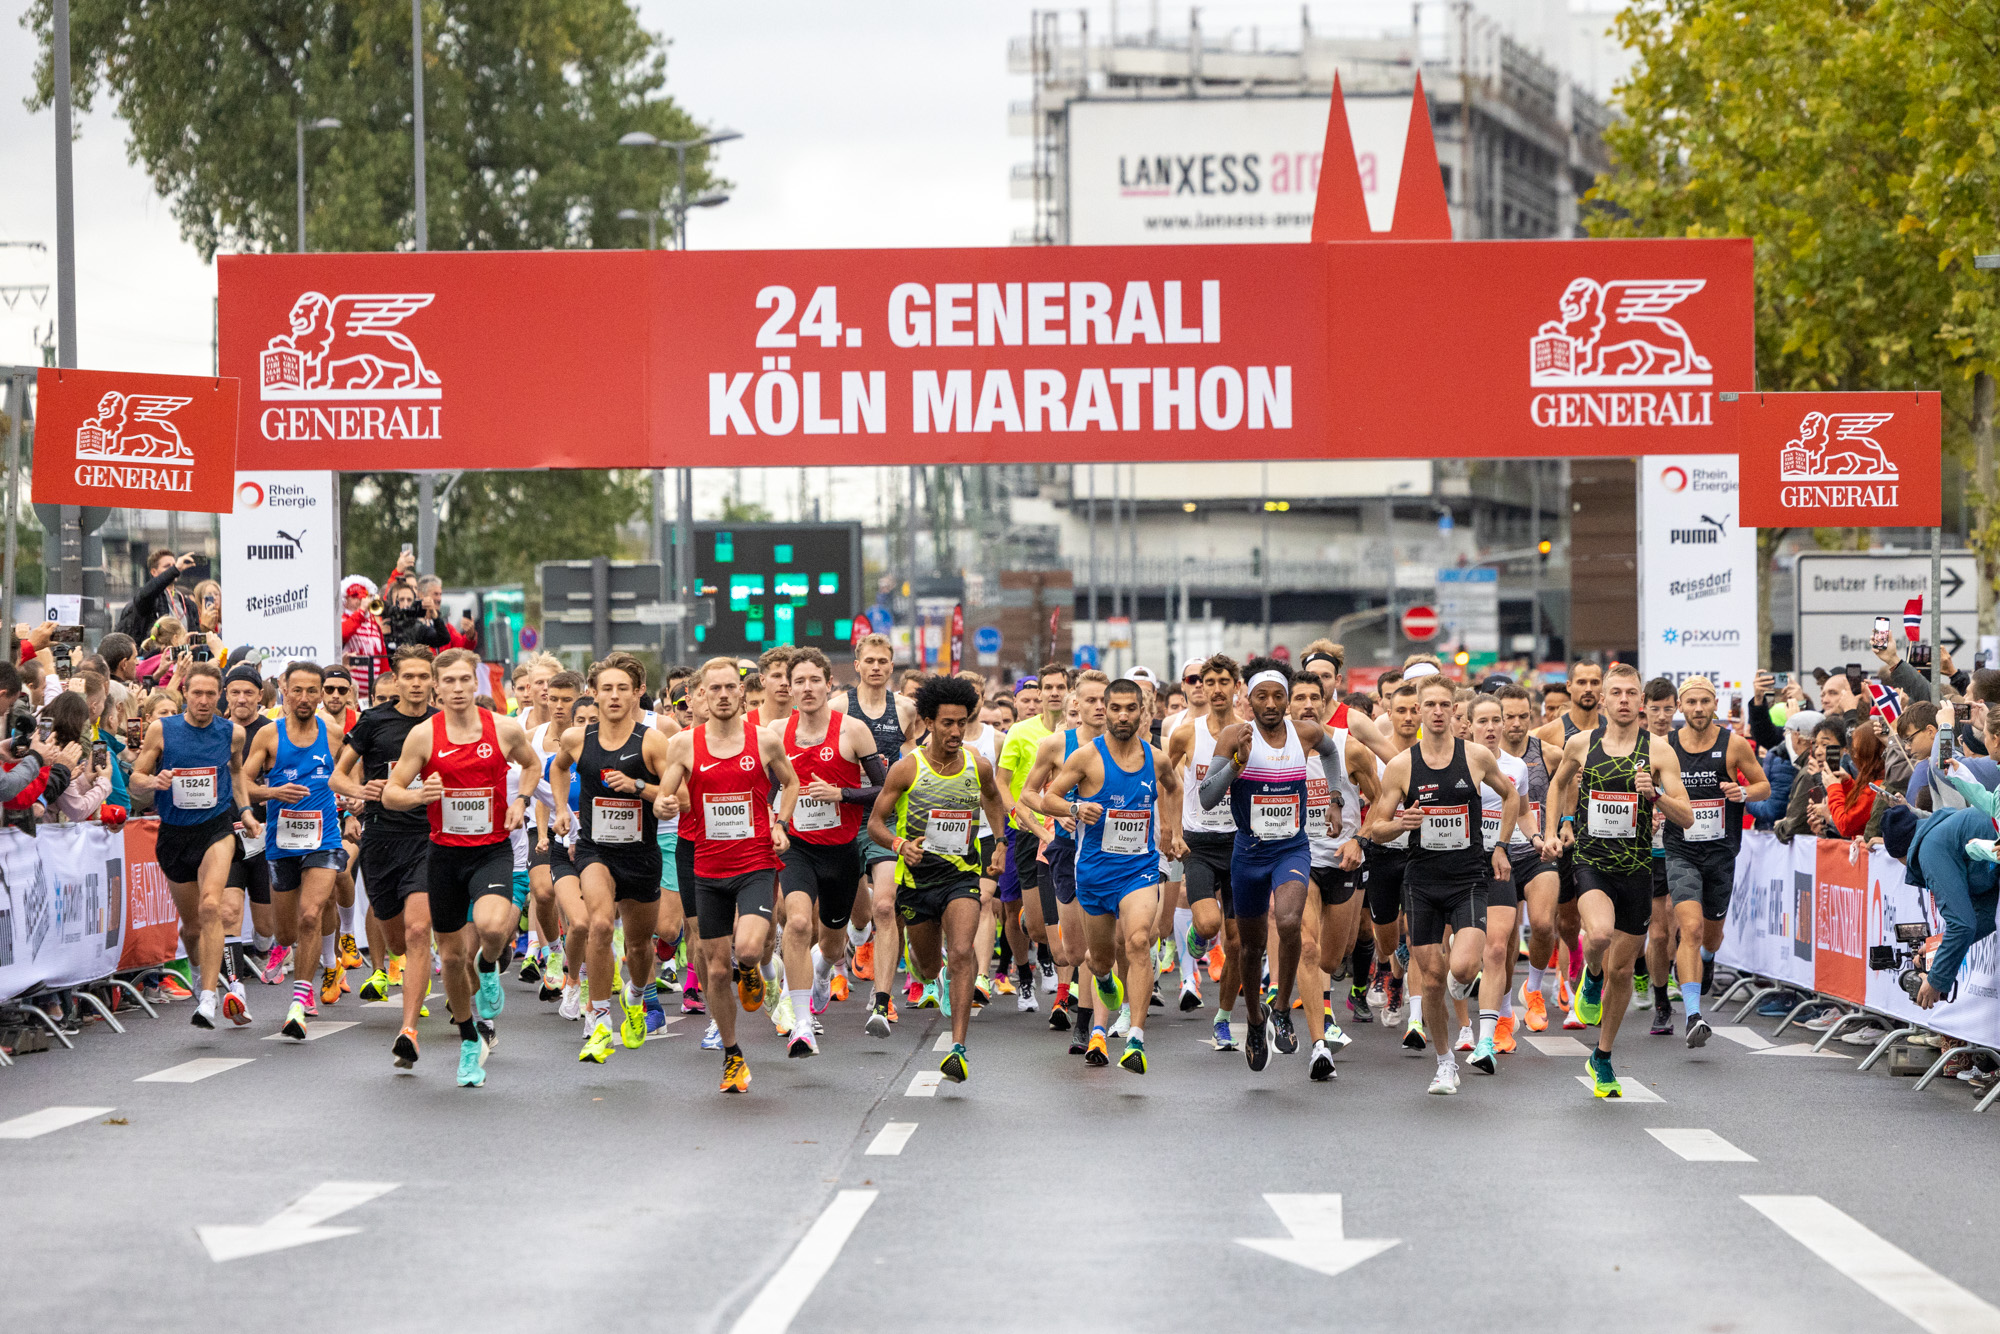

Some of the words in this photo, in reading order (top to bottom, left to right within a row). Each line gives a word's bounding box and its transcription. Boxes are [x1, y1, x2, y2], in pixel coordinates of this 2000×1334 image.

[1119, 153, 1261, 197] LANXESS
[1271, 152, 1377, 194] area
[755, 285, 862, 348] 24.
[887, 279, 1221, 348] GENERALI
[708, 355, 887, 436] KÖLN
[912, 365, 1293, 433] MARATHON
[1530, 391, 1713, 428] GENERALI
[260, 405, 442, 441] GENERALI
[74, 464, 194, 492] GENERALI
[1692, 469, 1728, 480] Rhein
[269, 484, 304, 495] Rhein
[269, 496, 316, 509] Energie
[1780, 485, 1899, 508] GENERALI
[1671, 529, 1718, 544] PUMA
[247, 544, 297, 560] PUMA
[1669, 568, 1732, 596] Reissdorf
[1813, 574, 1867, 592] Deutzer
[1874, 573, 1928, 592] Freiheit
[246, 584, 309, 612] Reissdorf
[263, 599, 308, 617] ALKOHOLFREI
[1682, 629, 1740, 647] pixum
[1680, 770, 1717, 778] BLACK
[180, 777, 211, 788] 15242
[1306, 780, 1328, 788] ILER
[450, 800, 485, 811] 10008
[711, 804, 746, 816] 10006
[1260, 806, 1293, 817] 10002
[1596, 802, 1630, 815] 10004
[601, 809, 634, 820] 17299
[285, 820, 316, 830] 14535
[936, 821, 966, 833] 10070
[1114, 820, 1144, 832] 10012
[1264, 820, 1288, 828] Samuel
[1428, 817, 1462, 828] 10016
